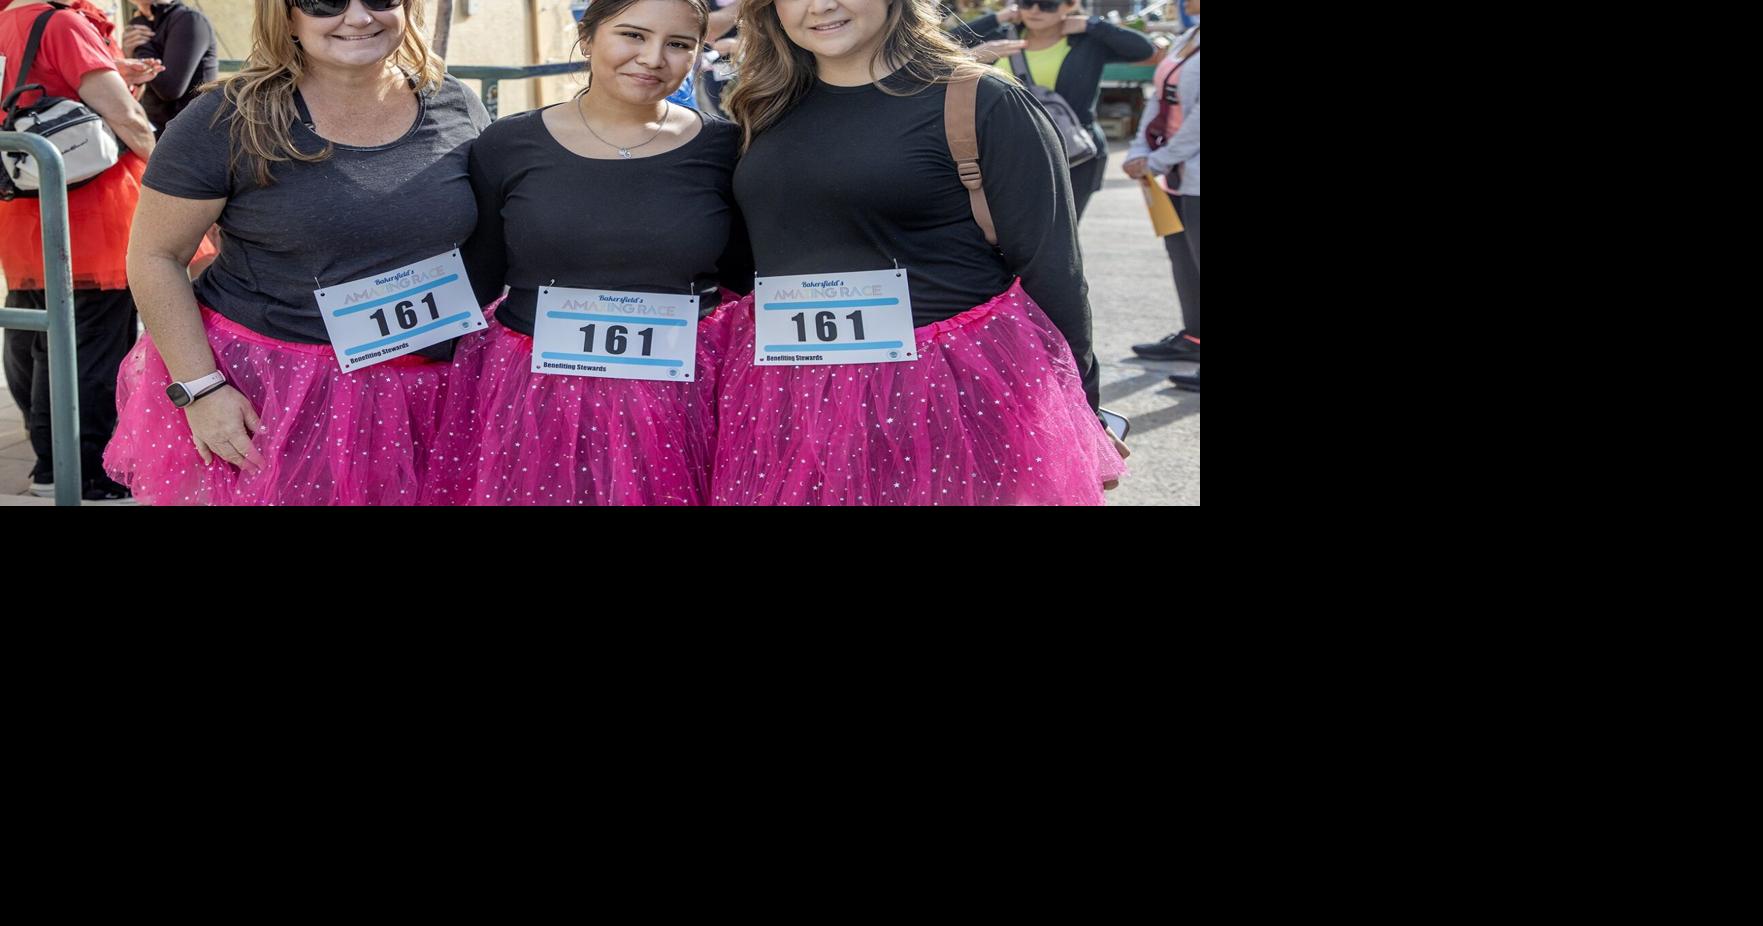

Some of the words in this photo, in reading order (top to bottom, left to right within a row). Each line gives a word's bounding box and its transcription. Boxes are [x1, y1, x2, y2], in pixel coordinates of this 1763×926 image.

[374, 269, 415, 286] Bakersfield's
[412, 265, 446, 285] RACE
[801, 279, 844, 289] Bakersfield's
[839, 285, 883, 297] RACE
[599, 295, 644, 304] Bakersfield's
[369, 292, 440, 337] 161
[637, 304, 676, 316] RACE
[791, 310, 865, 342] 161
[579, 323, 653, 356] 161
[350, 350, 382, 364] Benefiting
[382, 341, 409, 355] Stewards
[543, 361, 576, 370] Benefiting
[576, 364, 607, 372] Stewards
